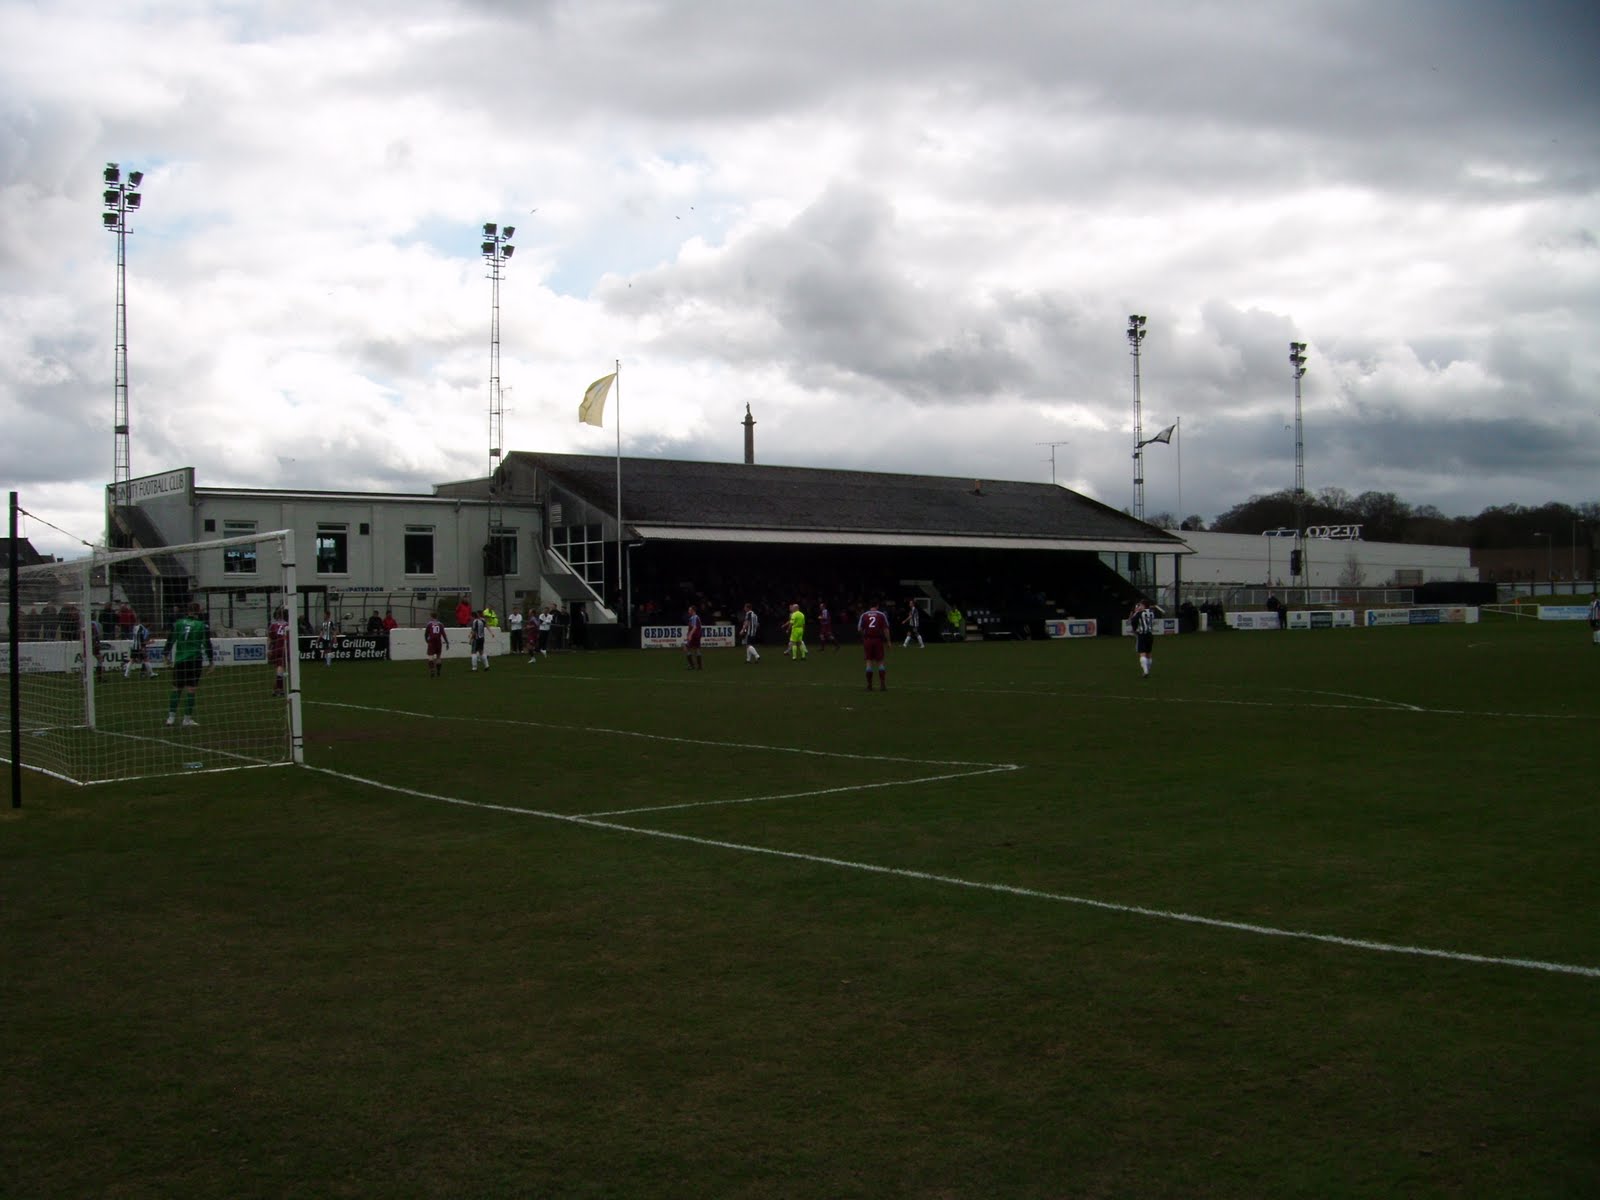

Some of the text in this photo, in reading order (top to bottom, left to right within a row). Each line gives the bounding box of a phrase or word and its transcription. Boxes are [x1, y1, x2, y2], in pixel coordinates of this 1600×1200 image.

[139, 478, 168, 496] FOOTBALL
[169, 474, 185, 491] CLUB
[868, 616, 876, 628] 2
[432, 624, 440, 634] 10
[644, 628, 682, 638] GEDDES
[342, 639, 376, 649] Grilling
[237, 648, 262, 658] FMS
[300, 648, 387, 659] ust Tstes Better!
